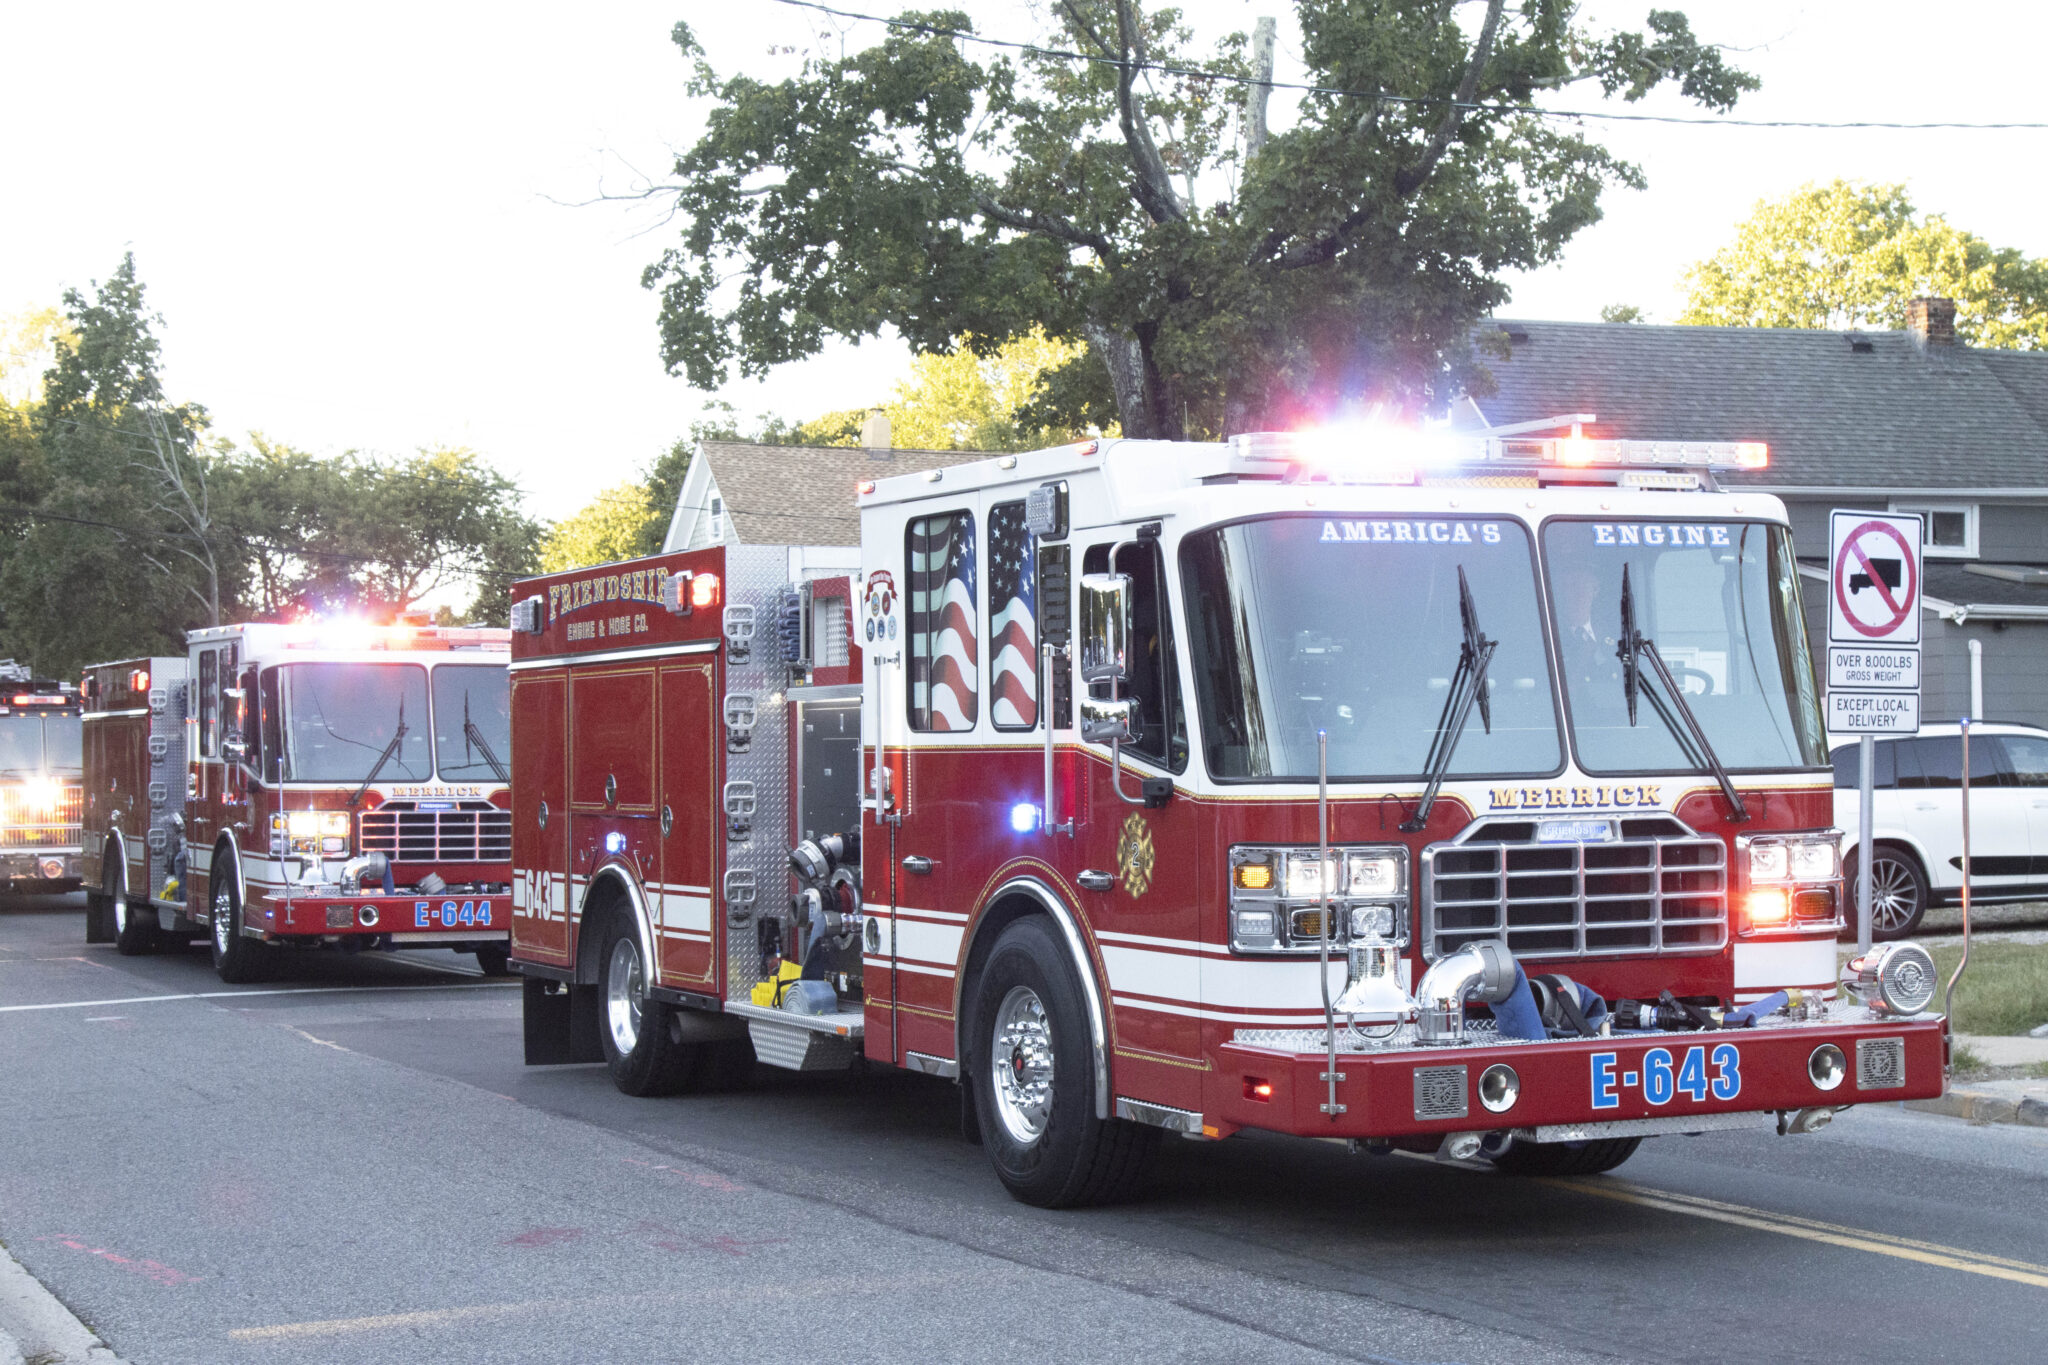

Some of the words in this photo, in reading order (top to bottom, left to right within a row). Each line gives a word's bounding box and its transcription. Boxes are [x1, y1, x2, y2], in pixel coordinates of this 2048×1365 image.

[1319, 521, 1501, 544] AMERICA'S
[1594, 523, 1731, 547] ENGINE
[567, 620, 596, 641] ENGINE
[598, 619, 605, 637] &
[608, 615, 631, 635] HOSE
[1836, 655, 1861, 667] OVER
[1846, 671, 1871, 681] GROSS
[1874, 671, 1901, 681] WEIGHT
[1876, 699, 1909, 712] LOCAL
[1848, 714, 1897, 726] DELIVERY
[392, 786, 481, 797] MERRICK
[1489, 785, 1662, 810] MERRICK
[525, 869, 551, 921] 643
[414, 900, 493, 928] E-644
[1590, 1043, 1742, 1110] E-643
